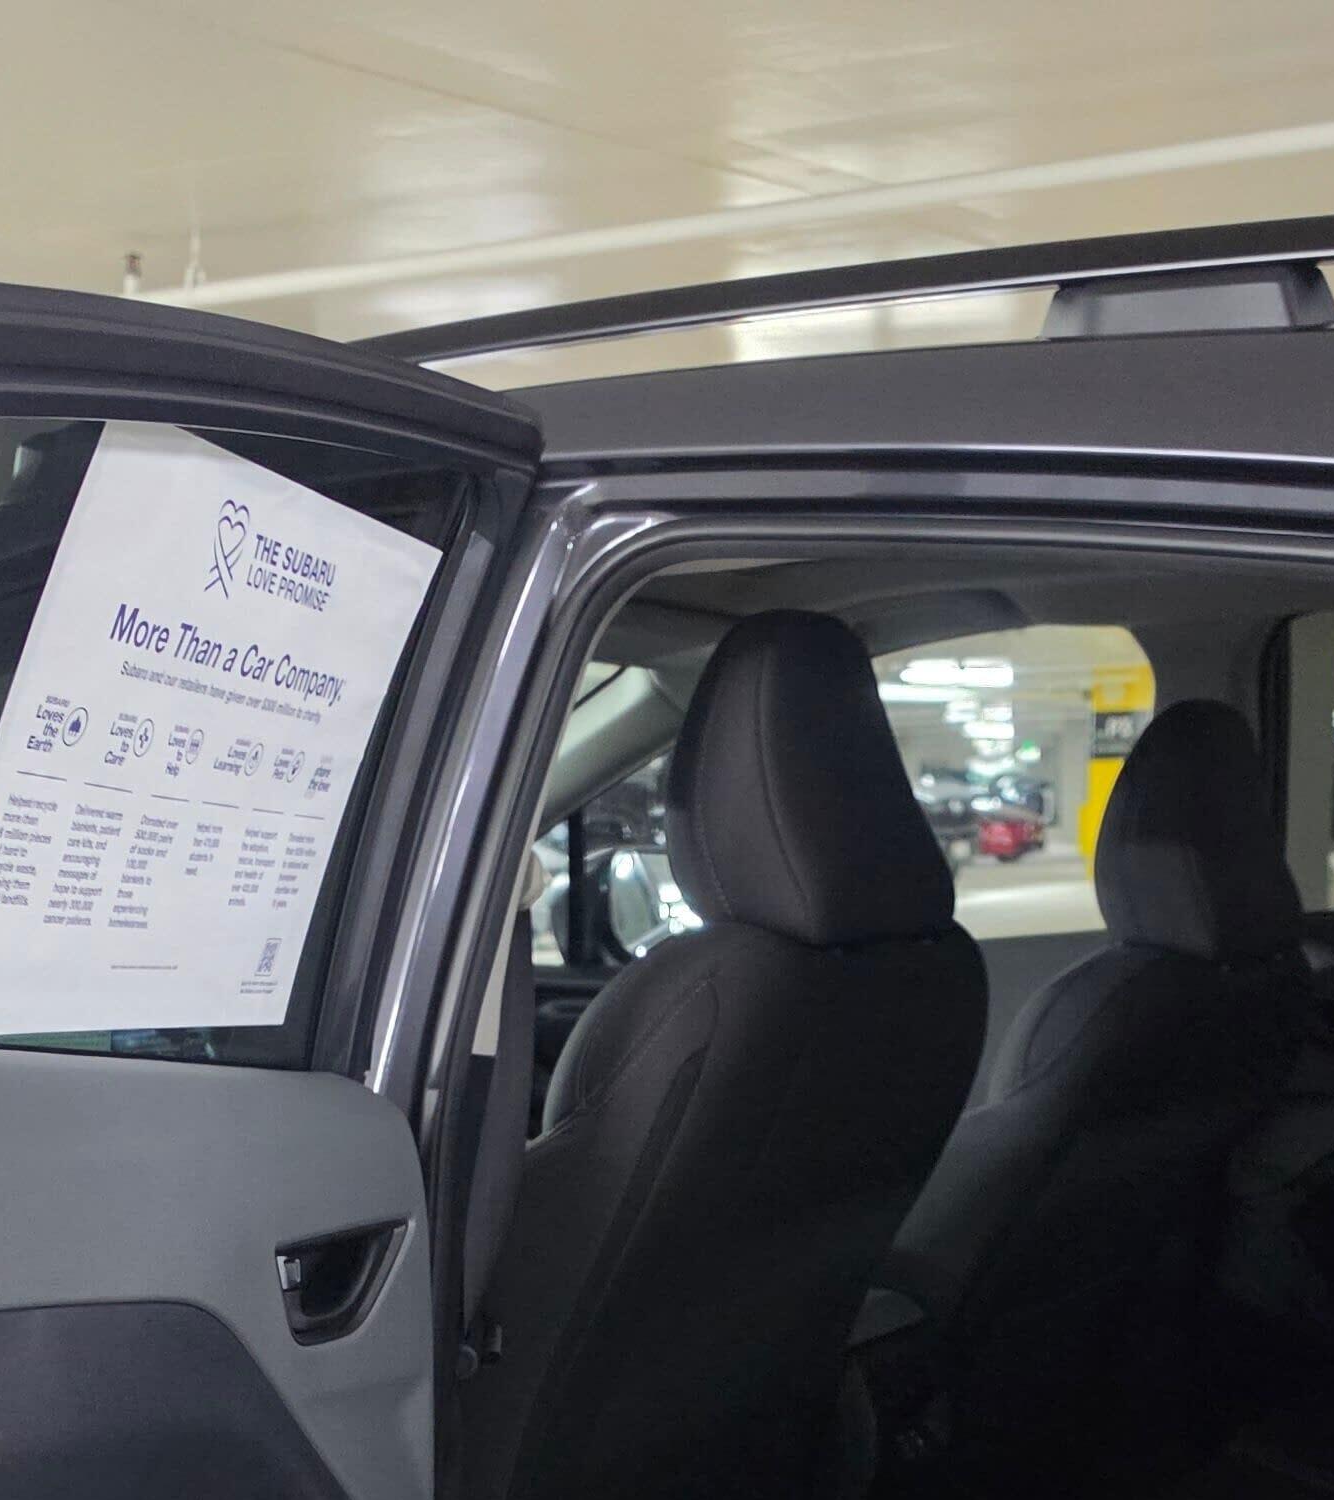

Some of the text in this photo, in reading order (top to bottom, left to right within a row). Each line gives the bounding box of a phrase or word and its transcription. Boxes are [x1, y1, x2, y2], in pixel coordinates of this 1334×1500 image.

[255, 533, 336, 587] THE SUBARU
[246, 564, 330, 612] LOVE PROMISE
[110, 603, 344, 707] More Than a Car Company.
[121, 660, 148, 681] Subaru
[148, 669, 162, 684] and
[36, 704, 65, 724] Loves
[42, 721, 59, 738] the
[110, 721, 134, 739] Loves
[27, 735, 53, 752] Earth
[120, 740, 129, 754] to
[168, 733, 187, 749] Loves
[104, 750, 125, 766] Care
[227, 746, 247, 760] Loves
